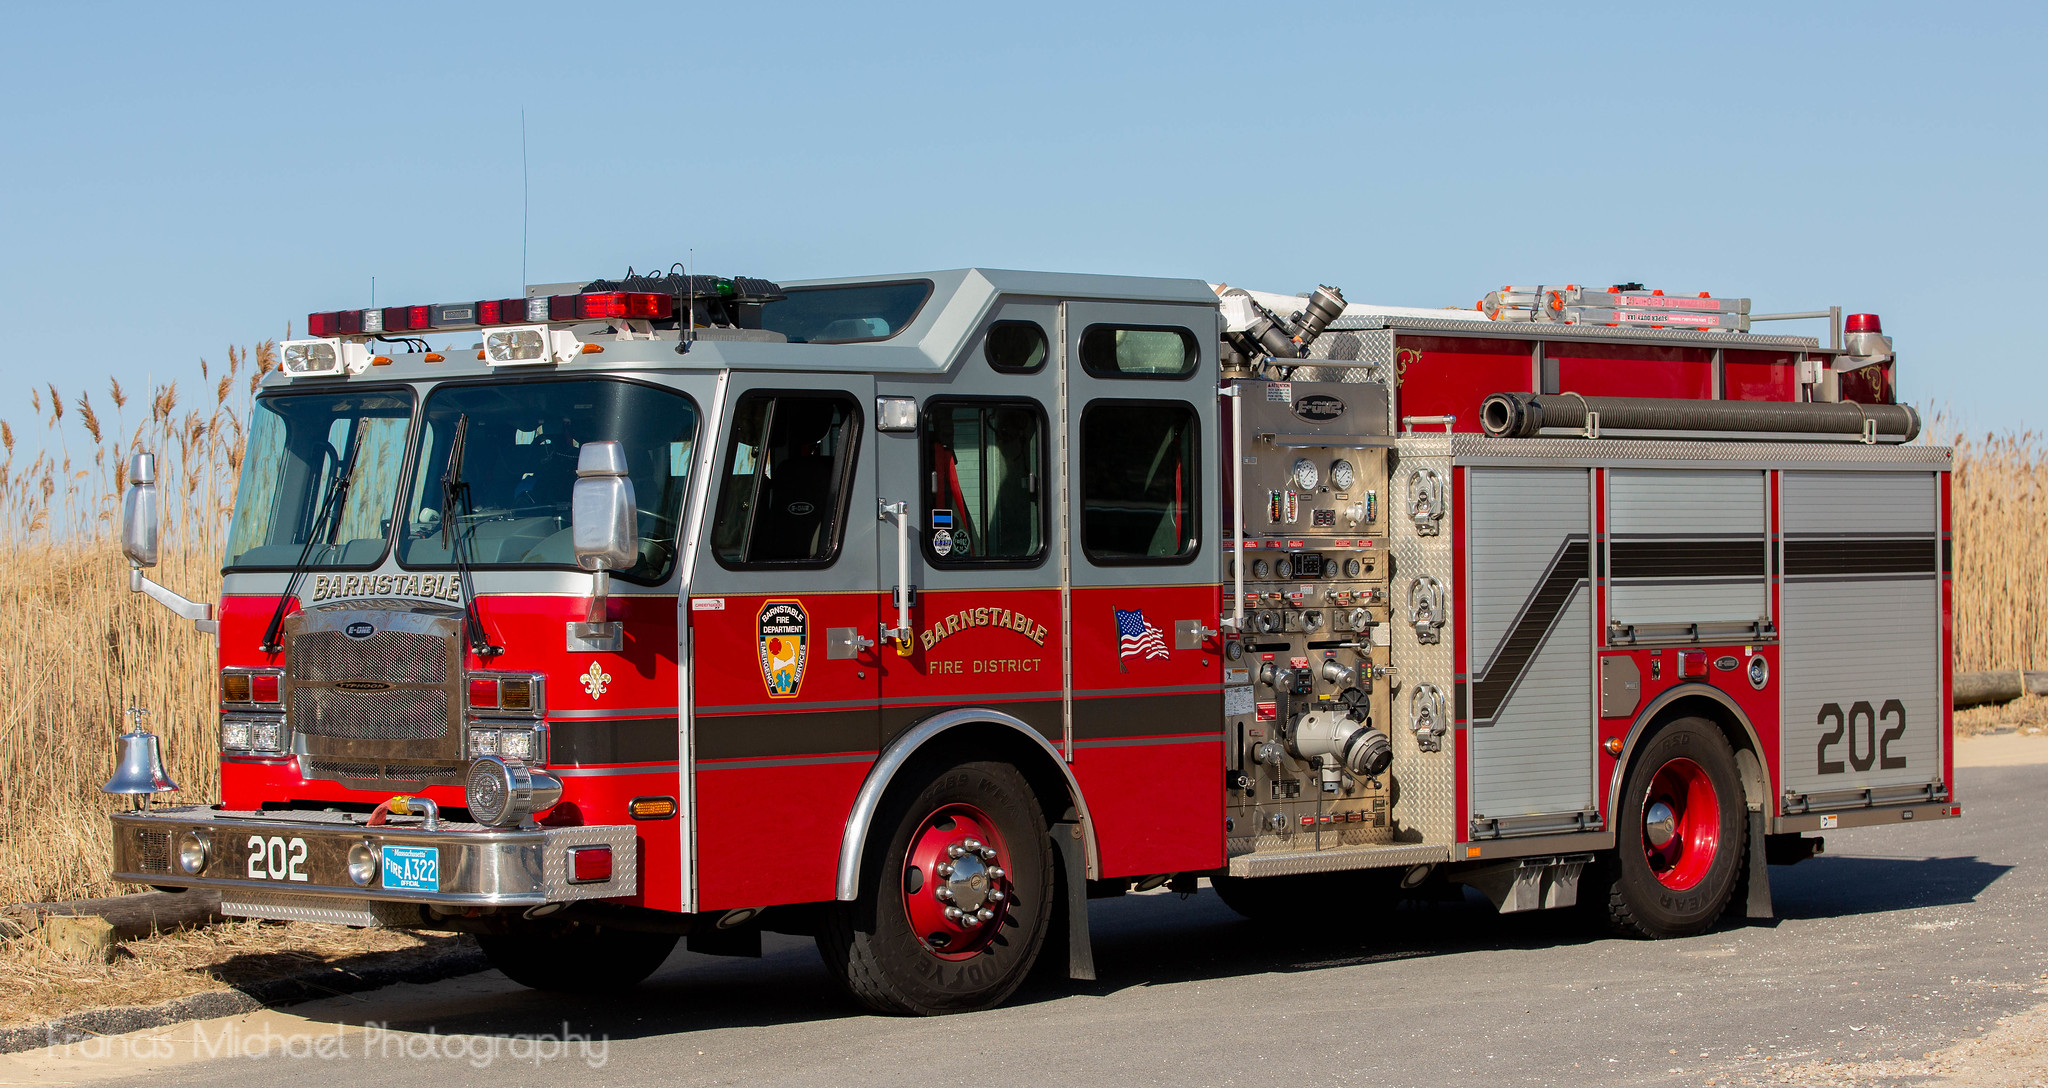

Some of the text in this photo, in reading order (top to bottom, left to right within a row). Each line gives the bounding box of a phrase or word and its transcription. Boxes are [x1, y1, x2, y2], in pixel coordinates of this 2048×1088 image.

[312, 574, 462, 602] BARNSTABLE
[762, 605, 804, 623] BARNSTABLE
[776, 616, 790, 624] FIRE
[763, 626, 803, 634] DEPARTMENT
[920, 606, 1048, 651] BARNSTABLE
[760, 641, 776, 688] EMERGENCY
[794, 644, 806, 683] SERVICES
[929, 658, 1041, 675] FIRE DISTRICT
[1816, 698, 1907, 775] 202
[248, 835, 308, 882] 202
[385, 857, 435, 881] FIRE A322
